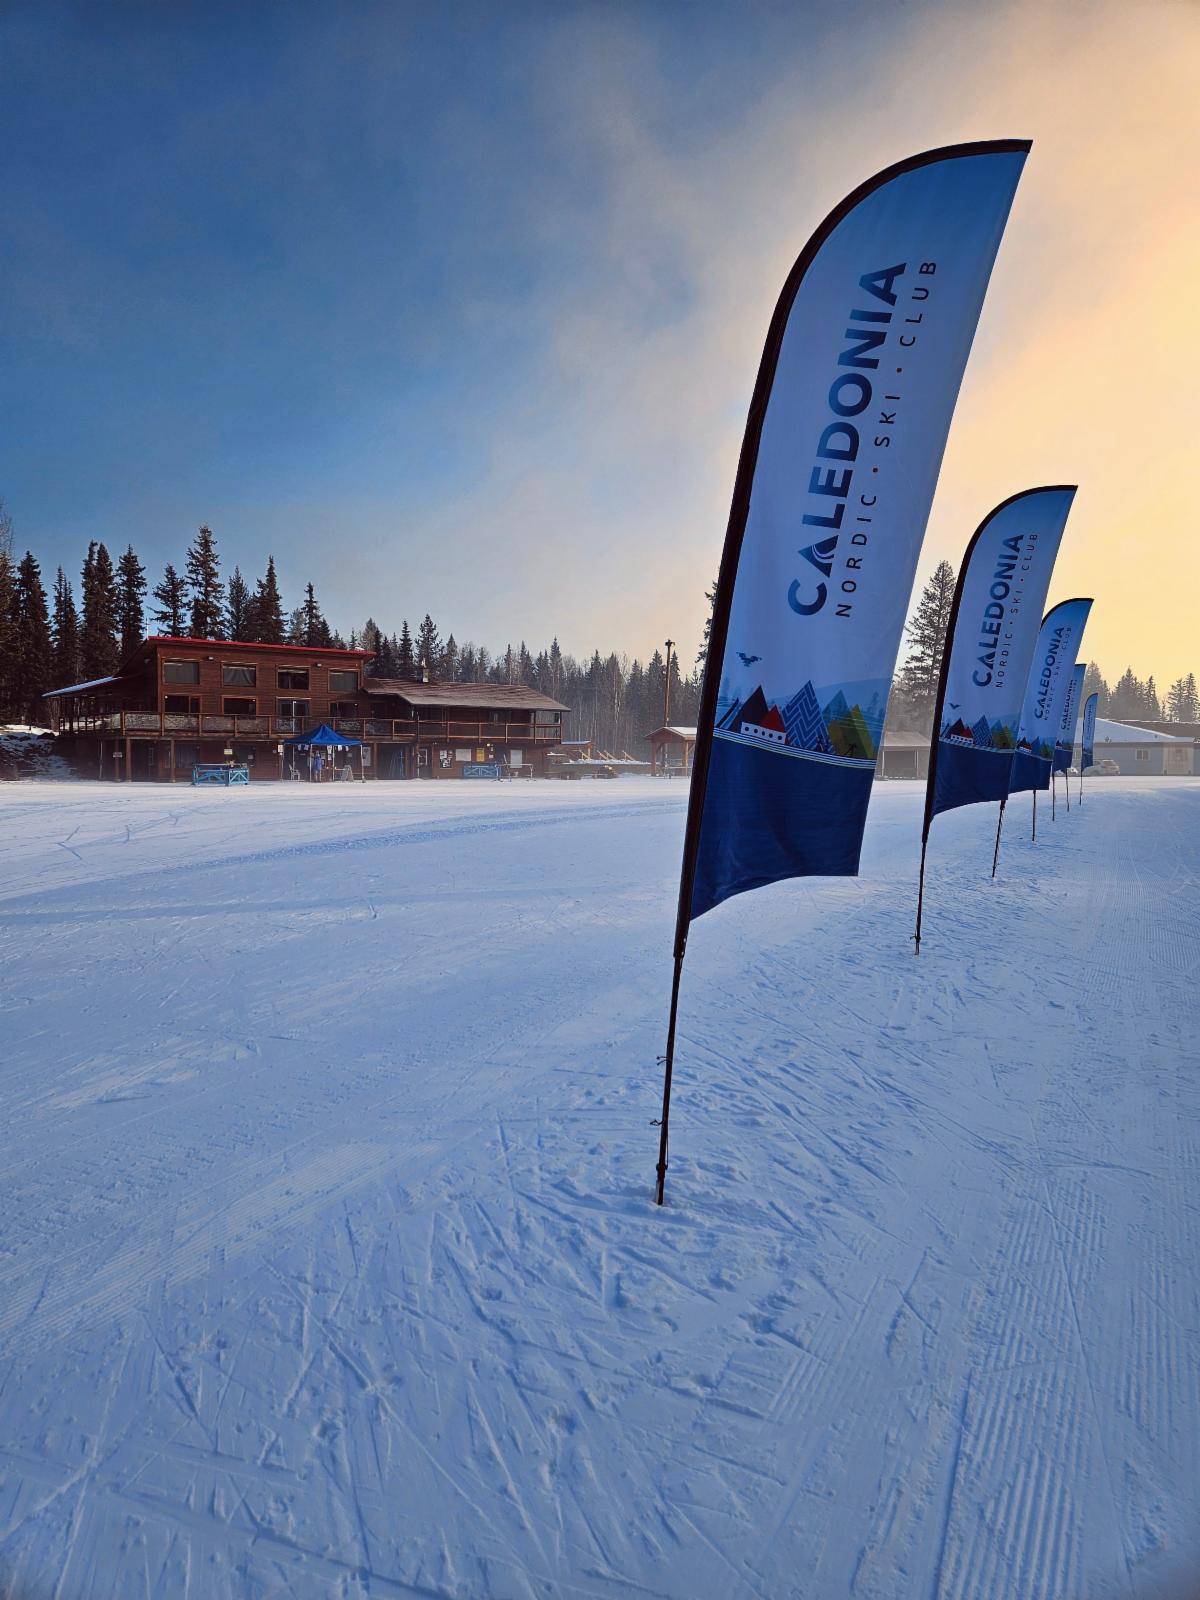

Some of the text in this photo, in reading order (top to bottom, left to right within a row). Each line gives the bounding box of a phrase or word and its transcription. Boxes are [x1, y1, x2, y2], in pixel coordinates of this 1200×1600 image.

[788, 262, 907, 616] CALEDONIA
[835, 261, 937, 618] NORDIC SKI CLUB
[972, 534, 1025, 687] CALEDONIA
[995, 533, 1038, 688] NORDIC SKI CLUB
[1034, 627, 1065, 719] CALEDONIA
